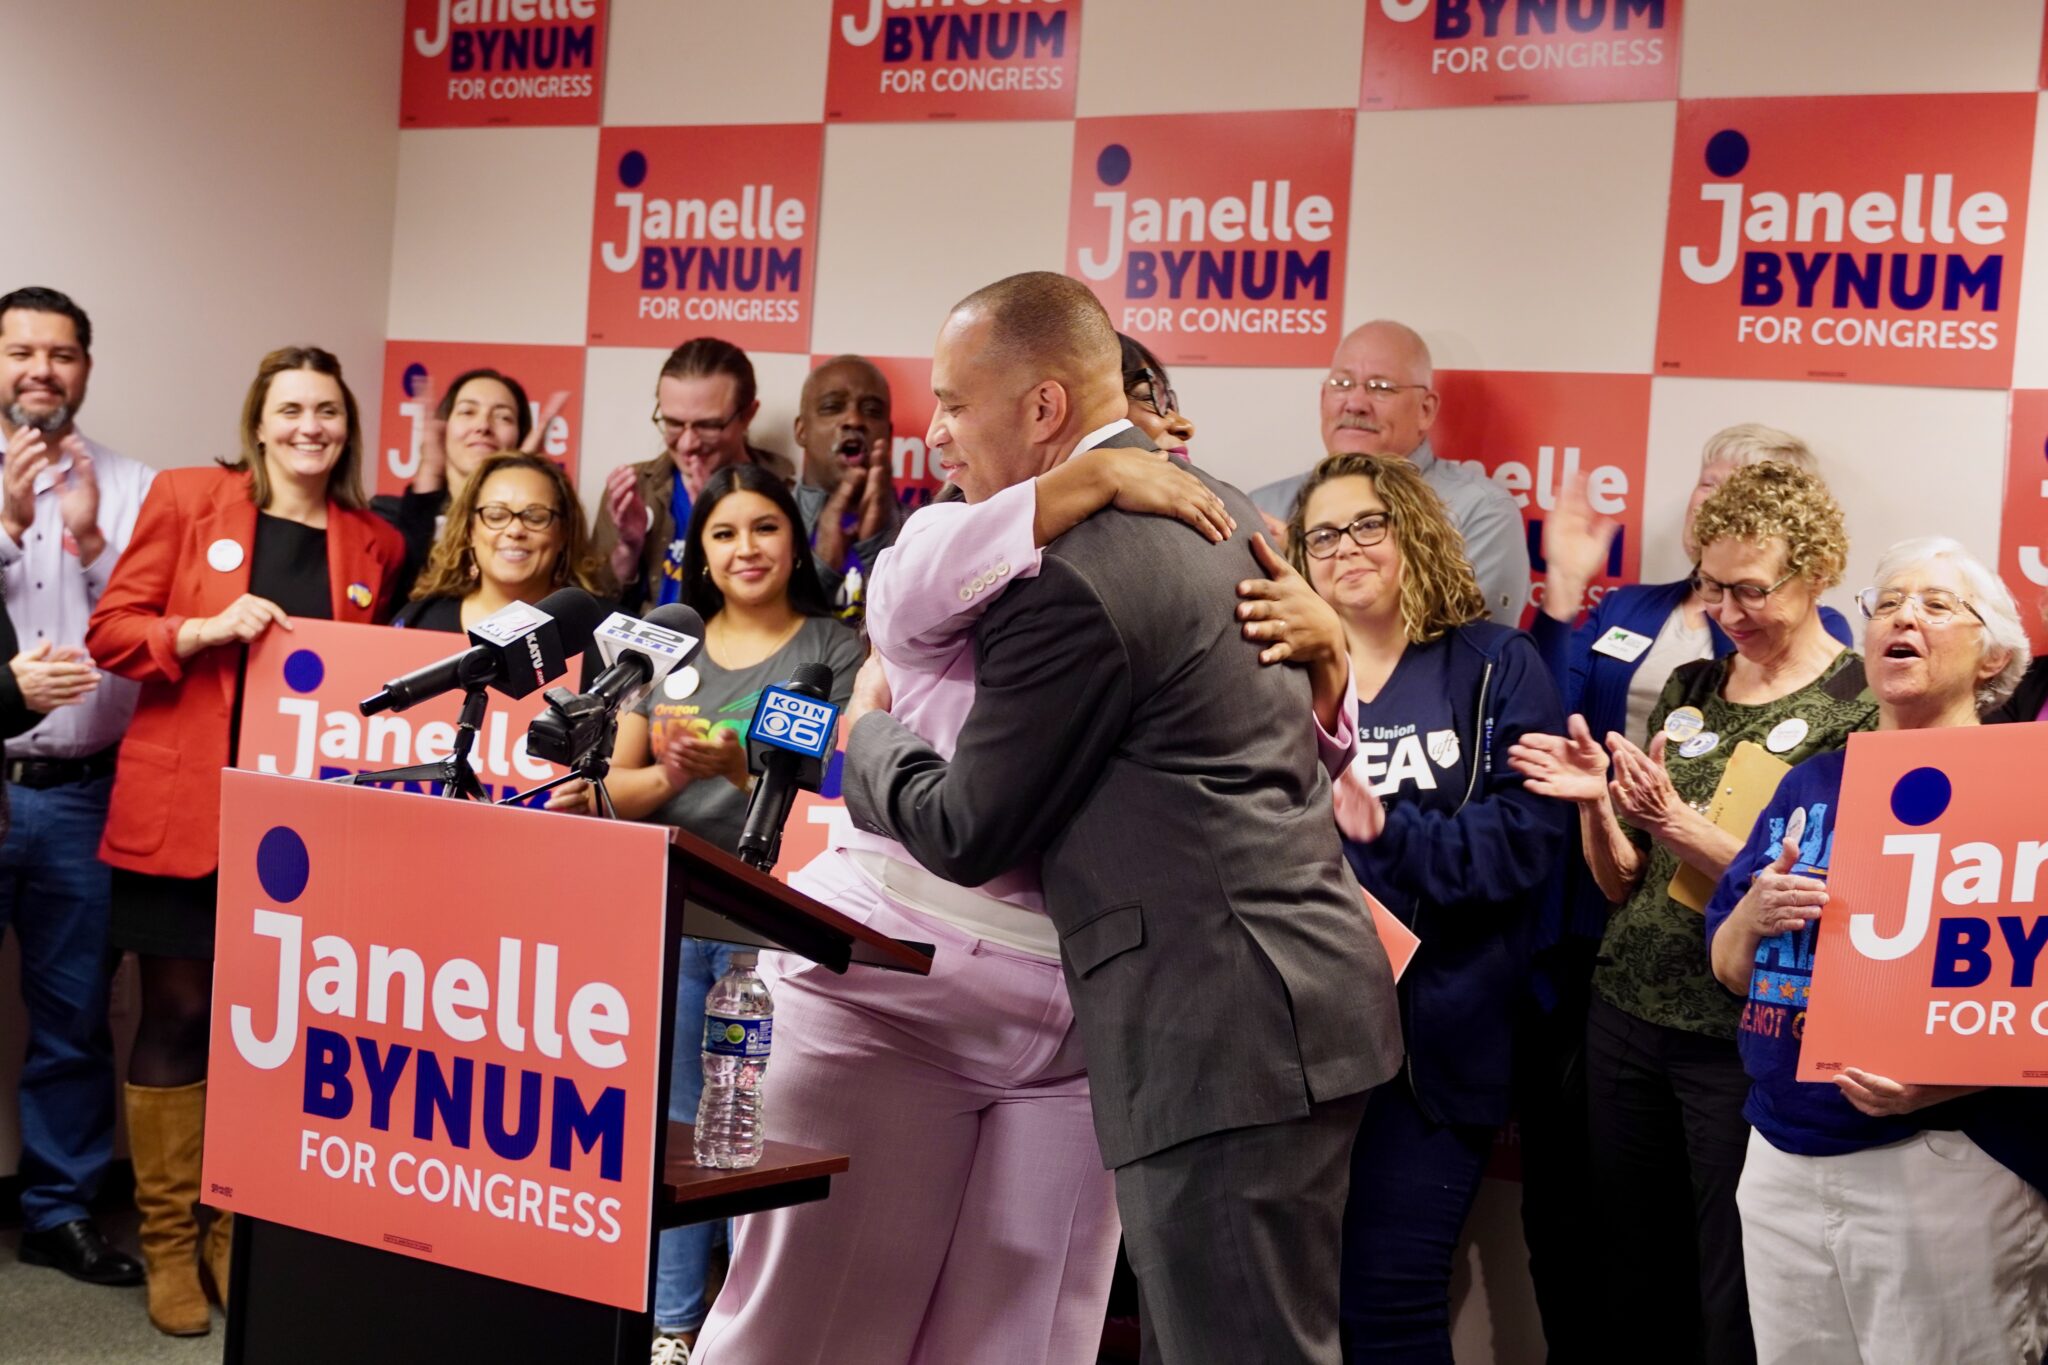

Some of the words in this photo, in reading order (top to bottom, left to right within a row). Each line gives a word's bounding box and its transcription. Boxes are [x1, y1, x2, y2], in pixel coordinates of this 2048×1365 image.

[883, 10, 1067, 62] BYNUM
[1434, 0, 1664, 40] BYNUM
[451, 25, 594, 72] BYNUM
[1432, 48, 1488, 74] FOR
[1496, 38, 1663, 71] CONGRESS
[448, 78, 486, 100] FOR
[489, 74, 592, 100] CONGRESS
[880, 69, 926, 93] FOR
[931, 66, 1063, 93] CONGRESS
[641, 246, 802, 292] BYNUM
[1125, 250, 1331, 300] BYNUM
[1740, 251, 2004, 311] BYNUM
[638, 297, 680, 319] FOR
[684, 298, 799, 323] CONGRESS
[1122, 307, 1173, 332] FOR
[1179, 307, 1328, 334] CONGRESS
[1737, 315, 1802, 344] FOR
[1811, 317, 1998, 351] CONGRESS
[612, 618, 684, 648] 12
[773, 696, 824, 719] KOIN
[1373, 724, 1416, 740] Union
[1925, 1000, 2016, 1035] FOR
[303, 1026, 626, 1182] BYNUM
[300, 1129, 376, 1187] FOR
[388, 1150, 622, 1243] CONGRESS
